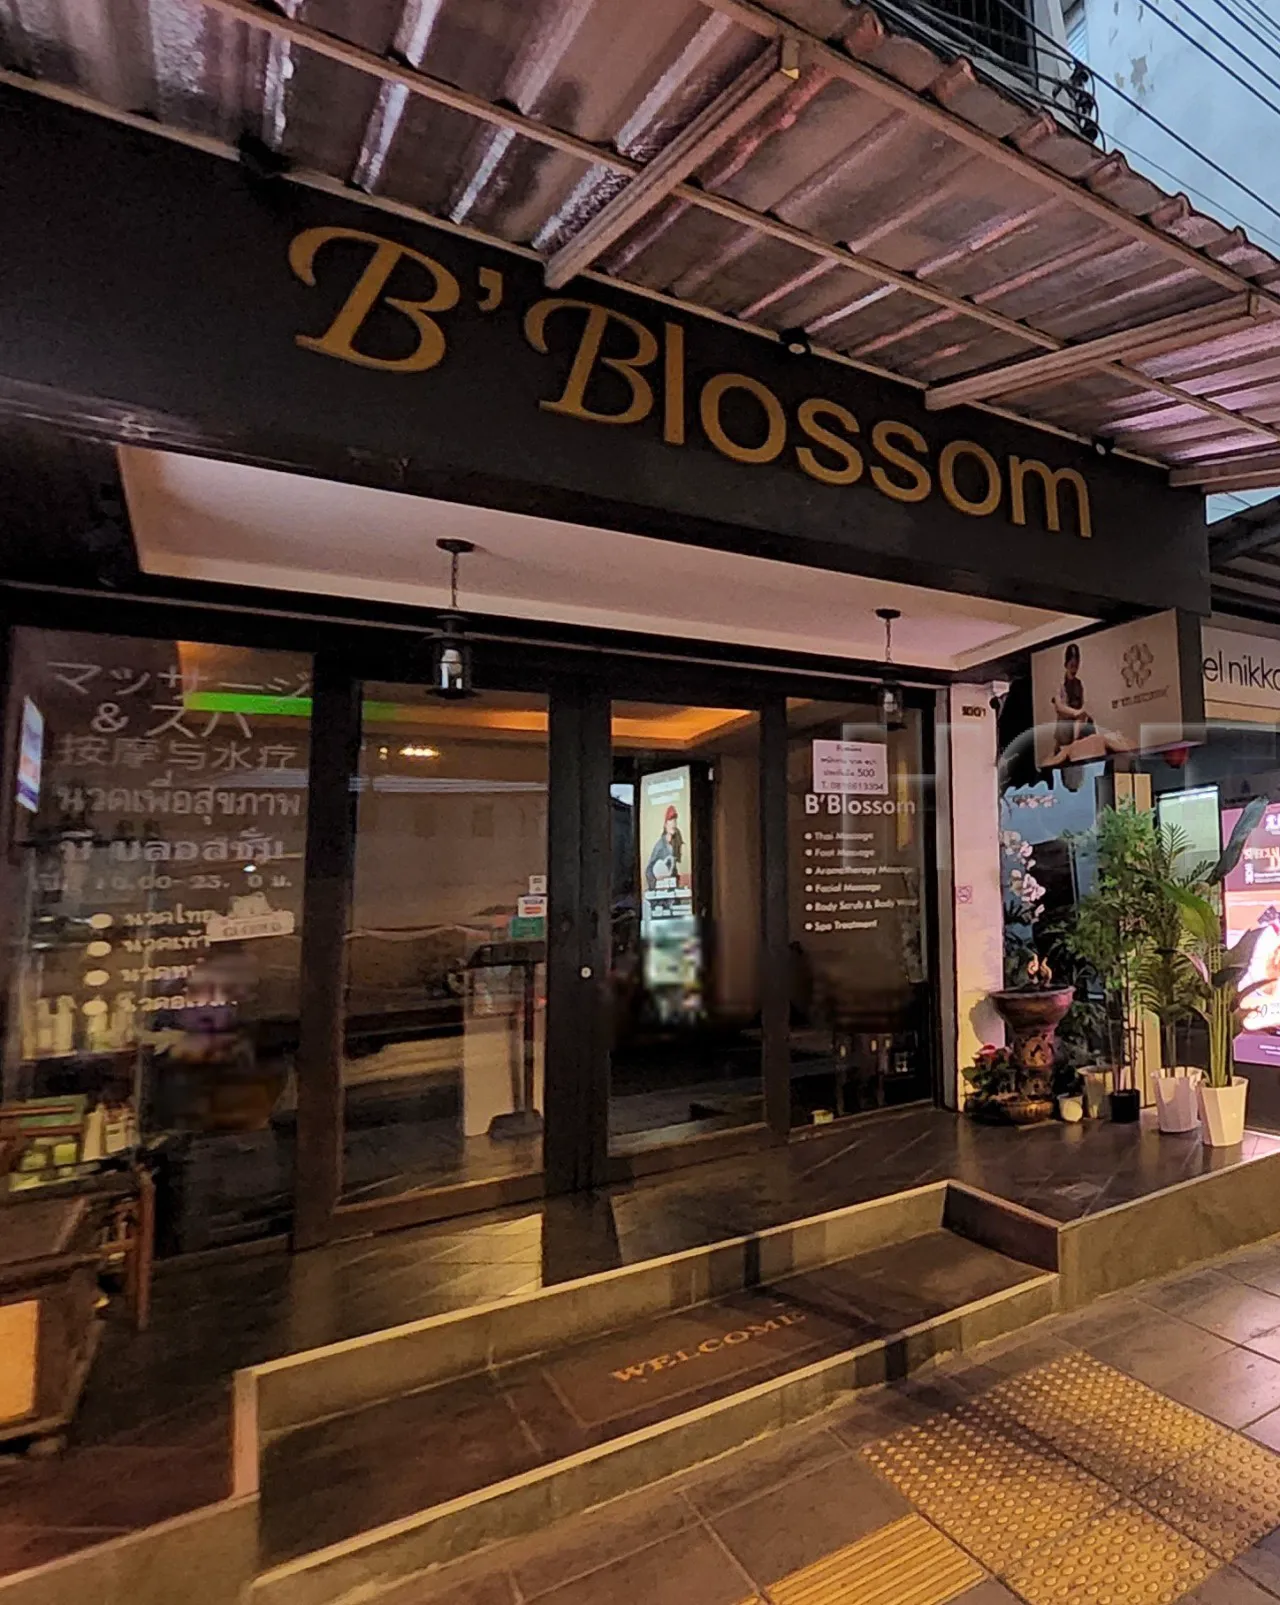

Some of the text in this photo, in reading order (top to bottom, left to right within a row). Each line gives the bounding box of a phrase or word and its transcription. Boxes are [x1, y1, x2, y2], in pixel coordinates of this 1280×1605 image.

[857, 768, 875, 778] 500
[805, 793, 916, 816] B'Blossom
[611, 1310, 806, 1383] WELCOME
